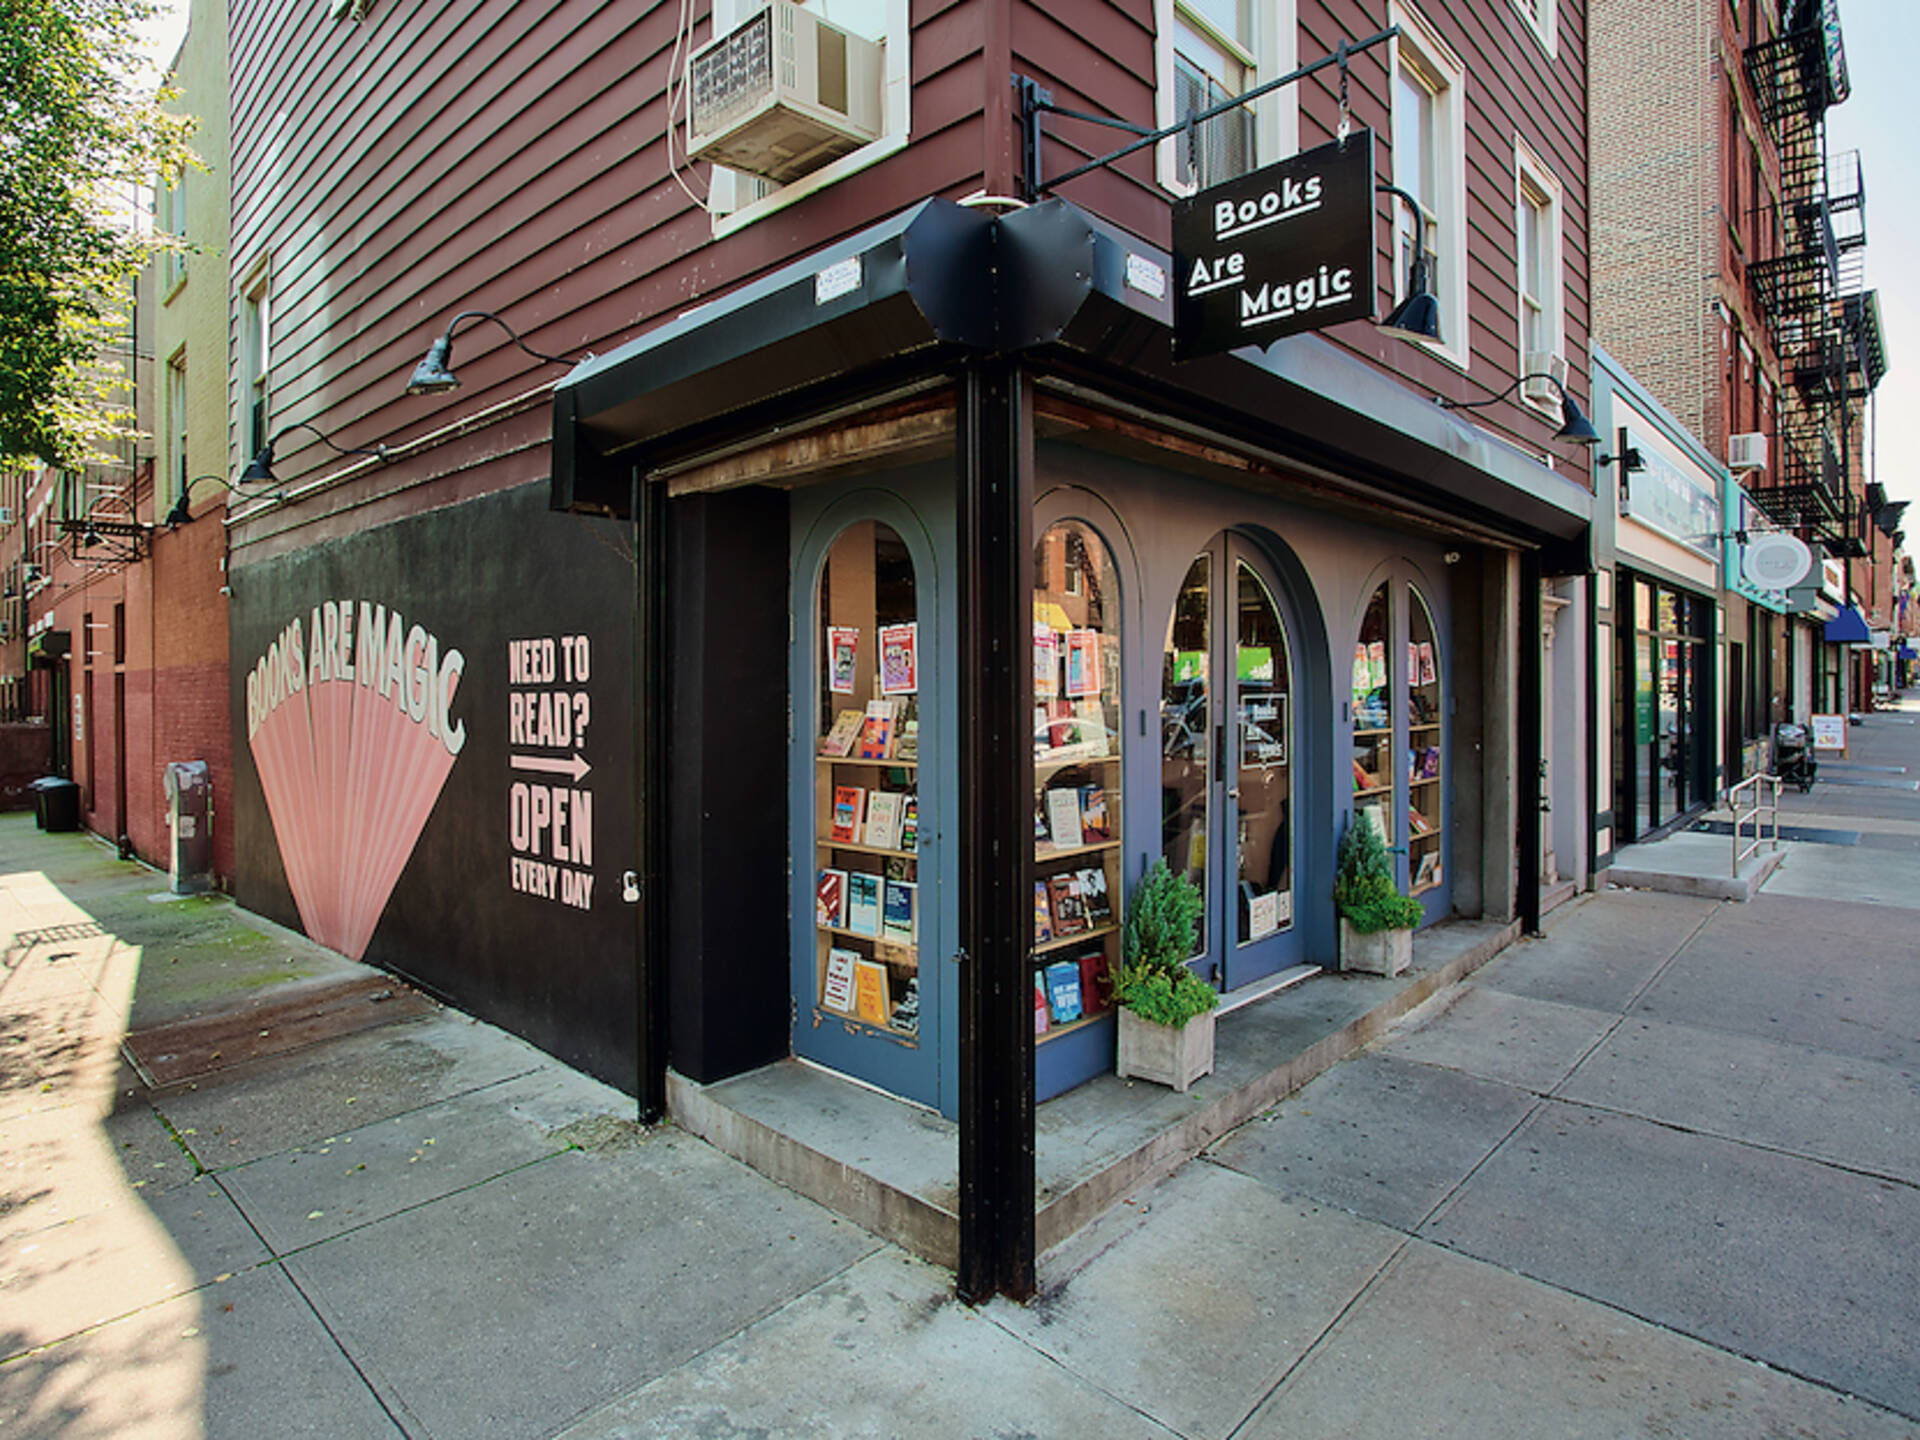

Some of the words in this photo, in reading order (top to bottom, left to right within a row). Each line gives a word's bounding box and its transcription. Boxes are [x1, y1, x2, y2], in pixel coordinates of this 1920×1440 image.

[1214, 175, 1322, 233] Books
[1188, 252, 1245, 288] Are
[1240, 265, 1352, 319] Magic
[246, 617, 306, 742] BOOKS
[308, 600, 355, 686] ARE
[357, 600, 466, 755] MAGIC
[509, 638, 555, 685] NEED
[561, 635, 591, 684] TO
[509, 692, 591, 749] READ?
[510, 782, 593, 867] OPEN
[510, 856, 559, 900] EVERY
[561, 869, 595, 911] DAY
